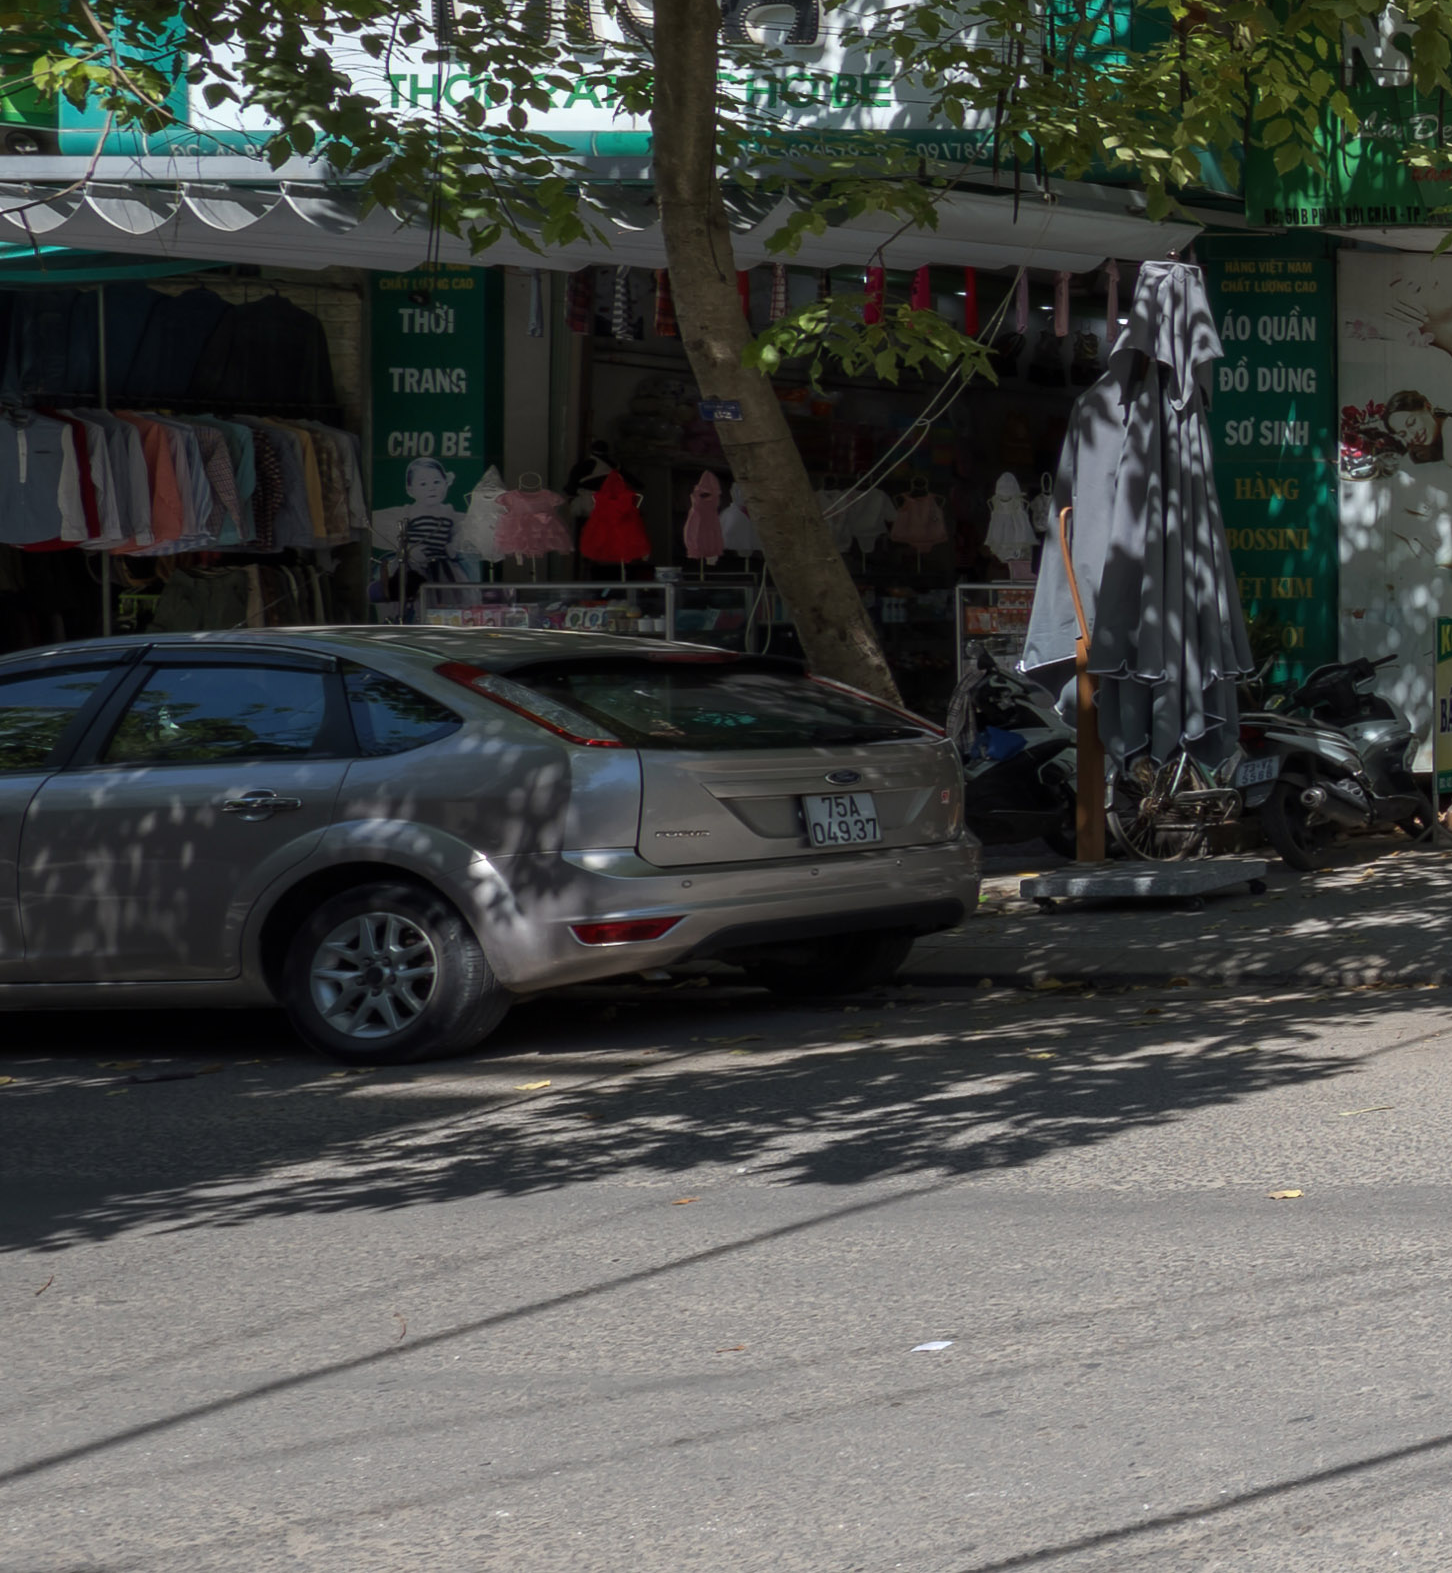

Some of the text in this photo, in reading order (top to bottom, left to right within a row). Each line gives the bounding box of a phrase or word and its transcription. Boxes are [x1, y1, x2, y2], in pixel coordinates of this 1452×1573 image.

[831, 60, 893, 108] BÉ
[1285, 206, 1308, 225] 50B
[1312, 206, 1341, 225] PHAN
[1367, 202, 1396, 224] CHÂU
[1224, 259, 1312, 275] HÀNG VIỆT NAM
[452, 278, 475, 291] CAO
[1221, 276, 1317, 294] CHẤT LƯỢNG CAO
[398, 302, 455, 334] THỜI
[1220, 305, 1316, 345] ÁO QUẦN
[389, 367, 467, 394] TRANG
[1218, 356, 1316, 394] ĐỒ DÙNG
[387, 426, 472, 457] CHO BÉ
[1224, 416, 1309, 446] SƠ SINH
[1234, 471, 1300, 500] HÀNG
[1225, 527, 1310, 551] BOSSINI
[1270, 577, 1314, 599] KIM
[821, 795, 861, 819] 75A
[812, 818, 878, 845] 049.37
